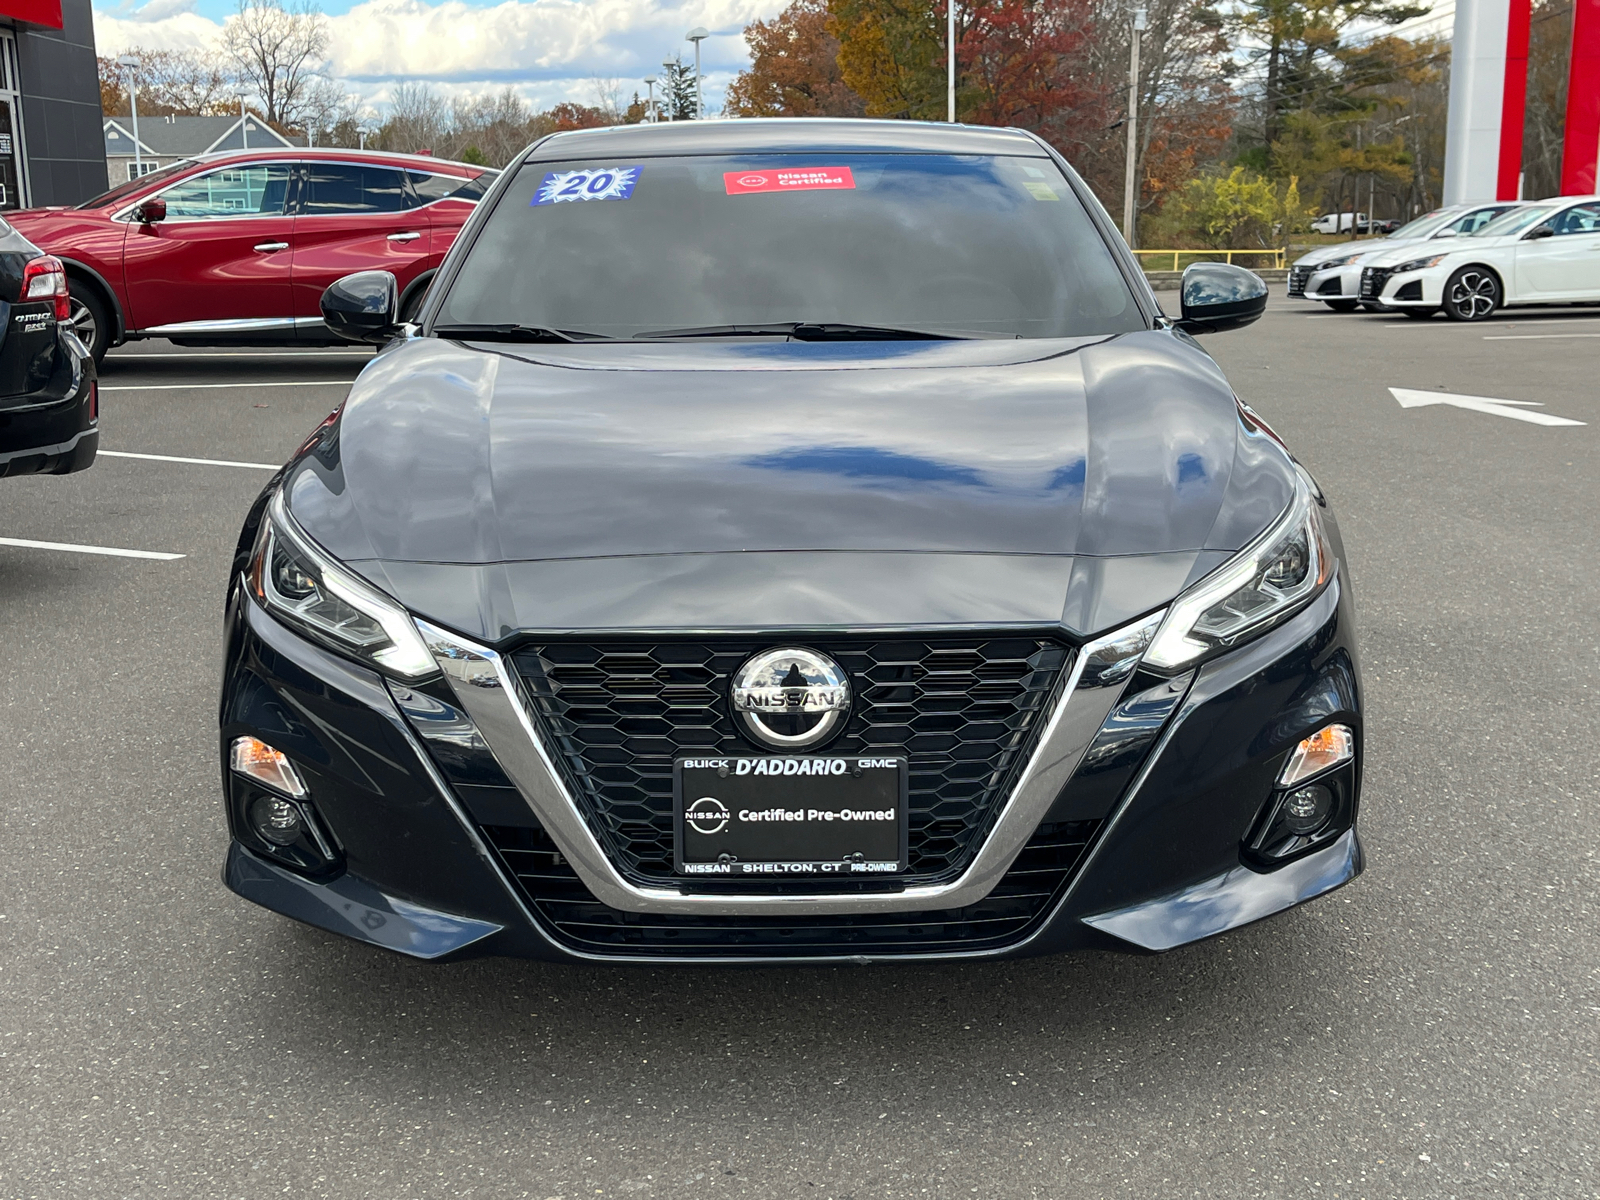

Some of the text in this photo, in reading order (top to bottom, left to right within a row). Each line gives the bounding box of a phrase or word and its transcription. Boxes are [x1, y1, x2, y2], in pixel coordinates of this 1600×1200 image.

[777, 172, 828, 180] Nissan
[556, 173, 613, 196] 20
[778, 177, 843, 186] Certified
[746, 691, 835, 707] NISSAN
[683, 759, 729, 768] BUICK
[735, 758, 847, 776] D'ADDARIO
[857, 758, 898, 768] GMC
[684, 811, 731, 820] NISSAN
[738, 807, 895, 821] Certified Pre-Owned
[684, 864, 731, 873] NISSAN
[742, 863, 842, 873] SHELTON, CT
[850, 863, 898, 872] PRE-OWNED
